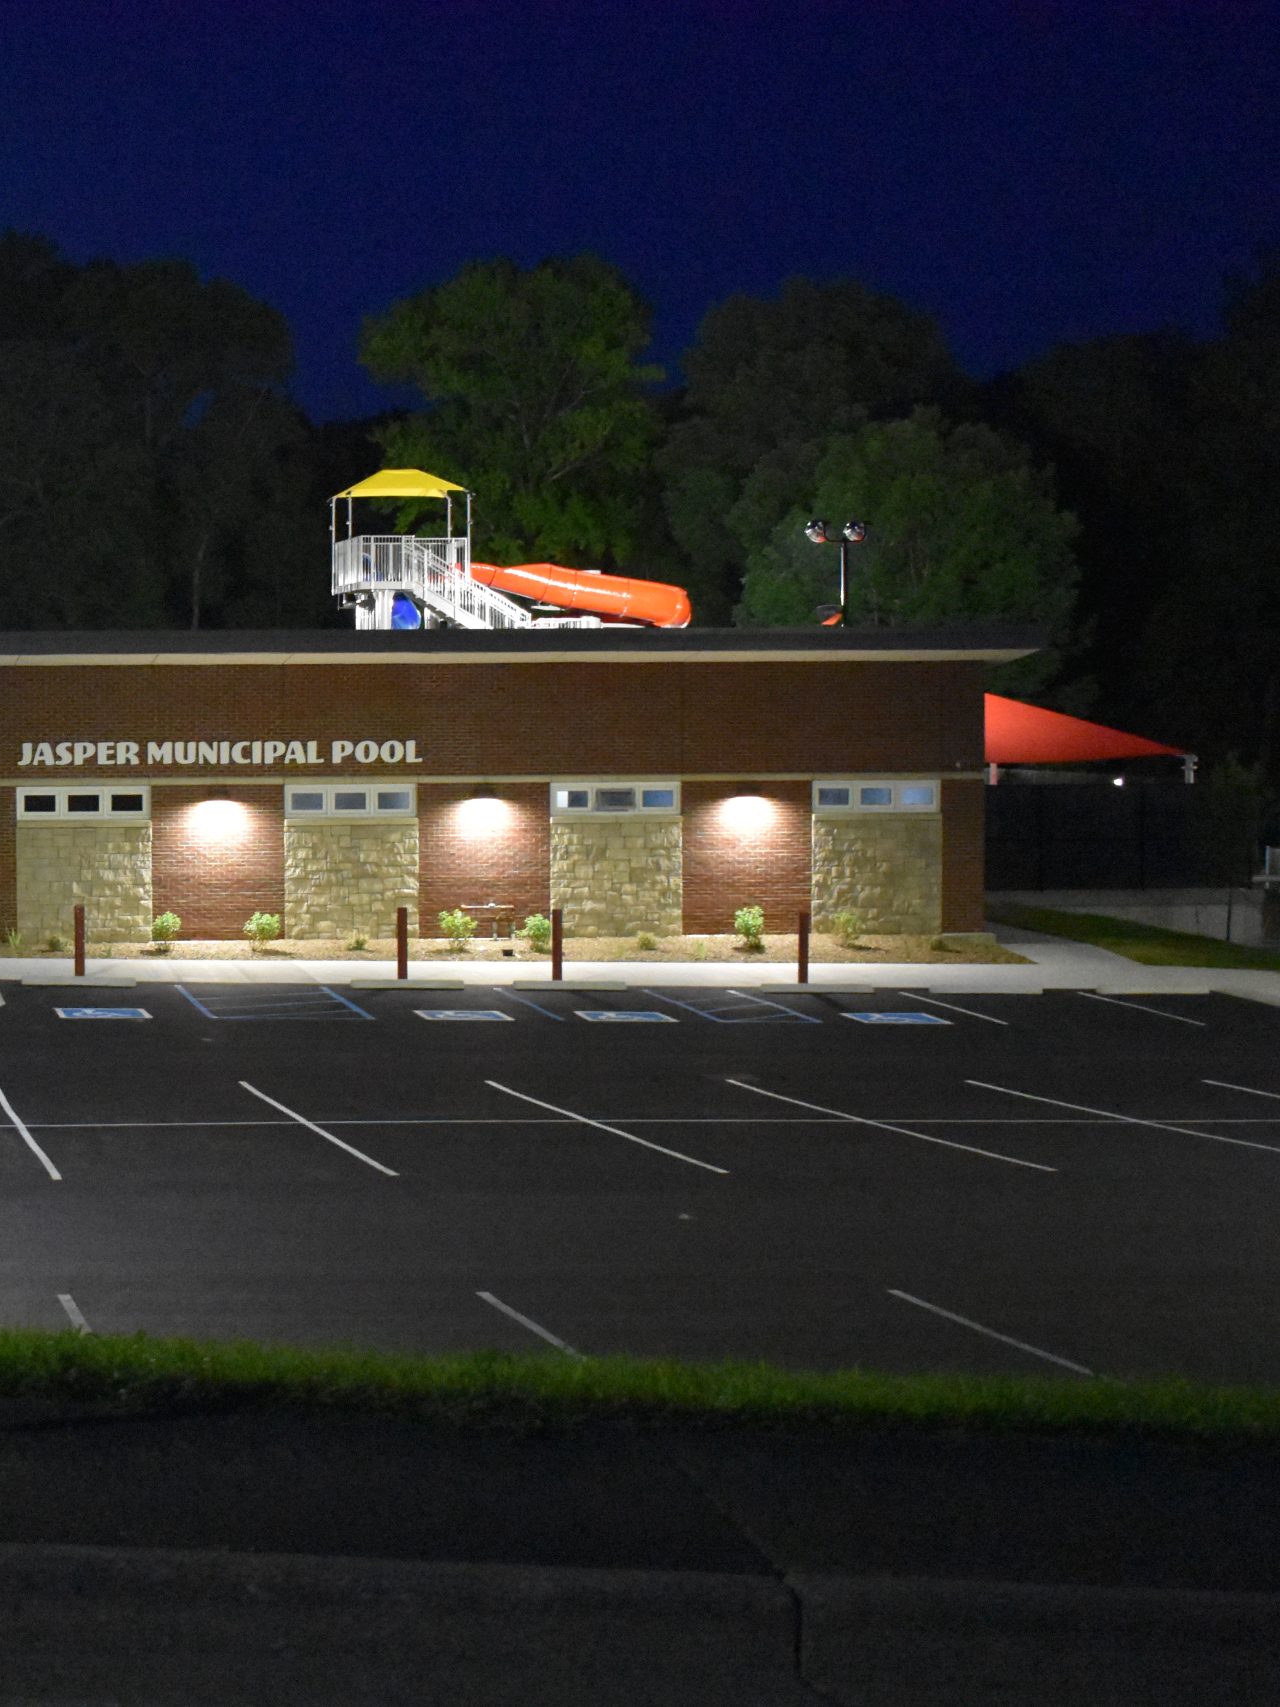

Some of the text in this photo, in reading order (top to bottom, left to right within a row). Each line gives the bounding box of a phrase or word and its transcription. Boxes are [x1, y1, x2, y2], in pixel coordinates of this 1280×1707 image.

[17, 739, 423, 766] JASPER MUNICIPAL POOL
